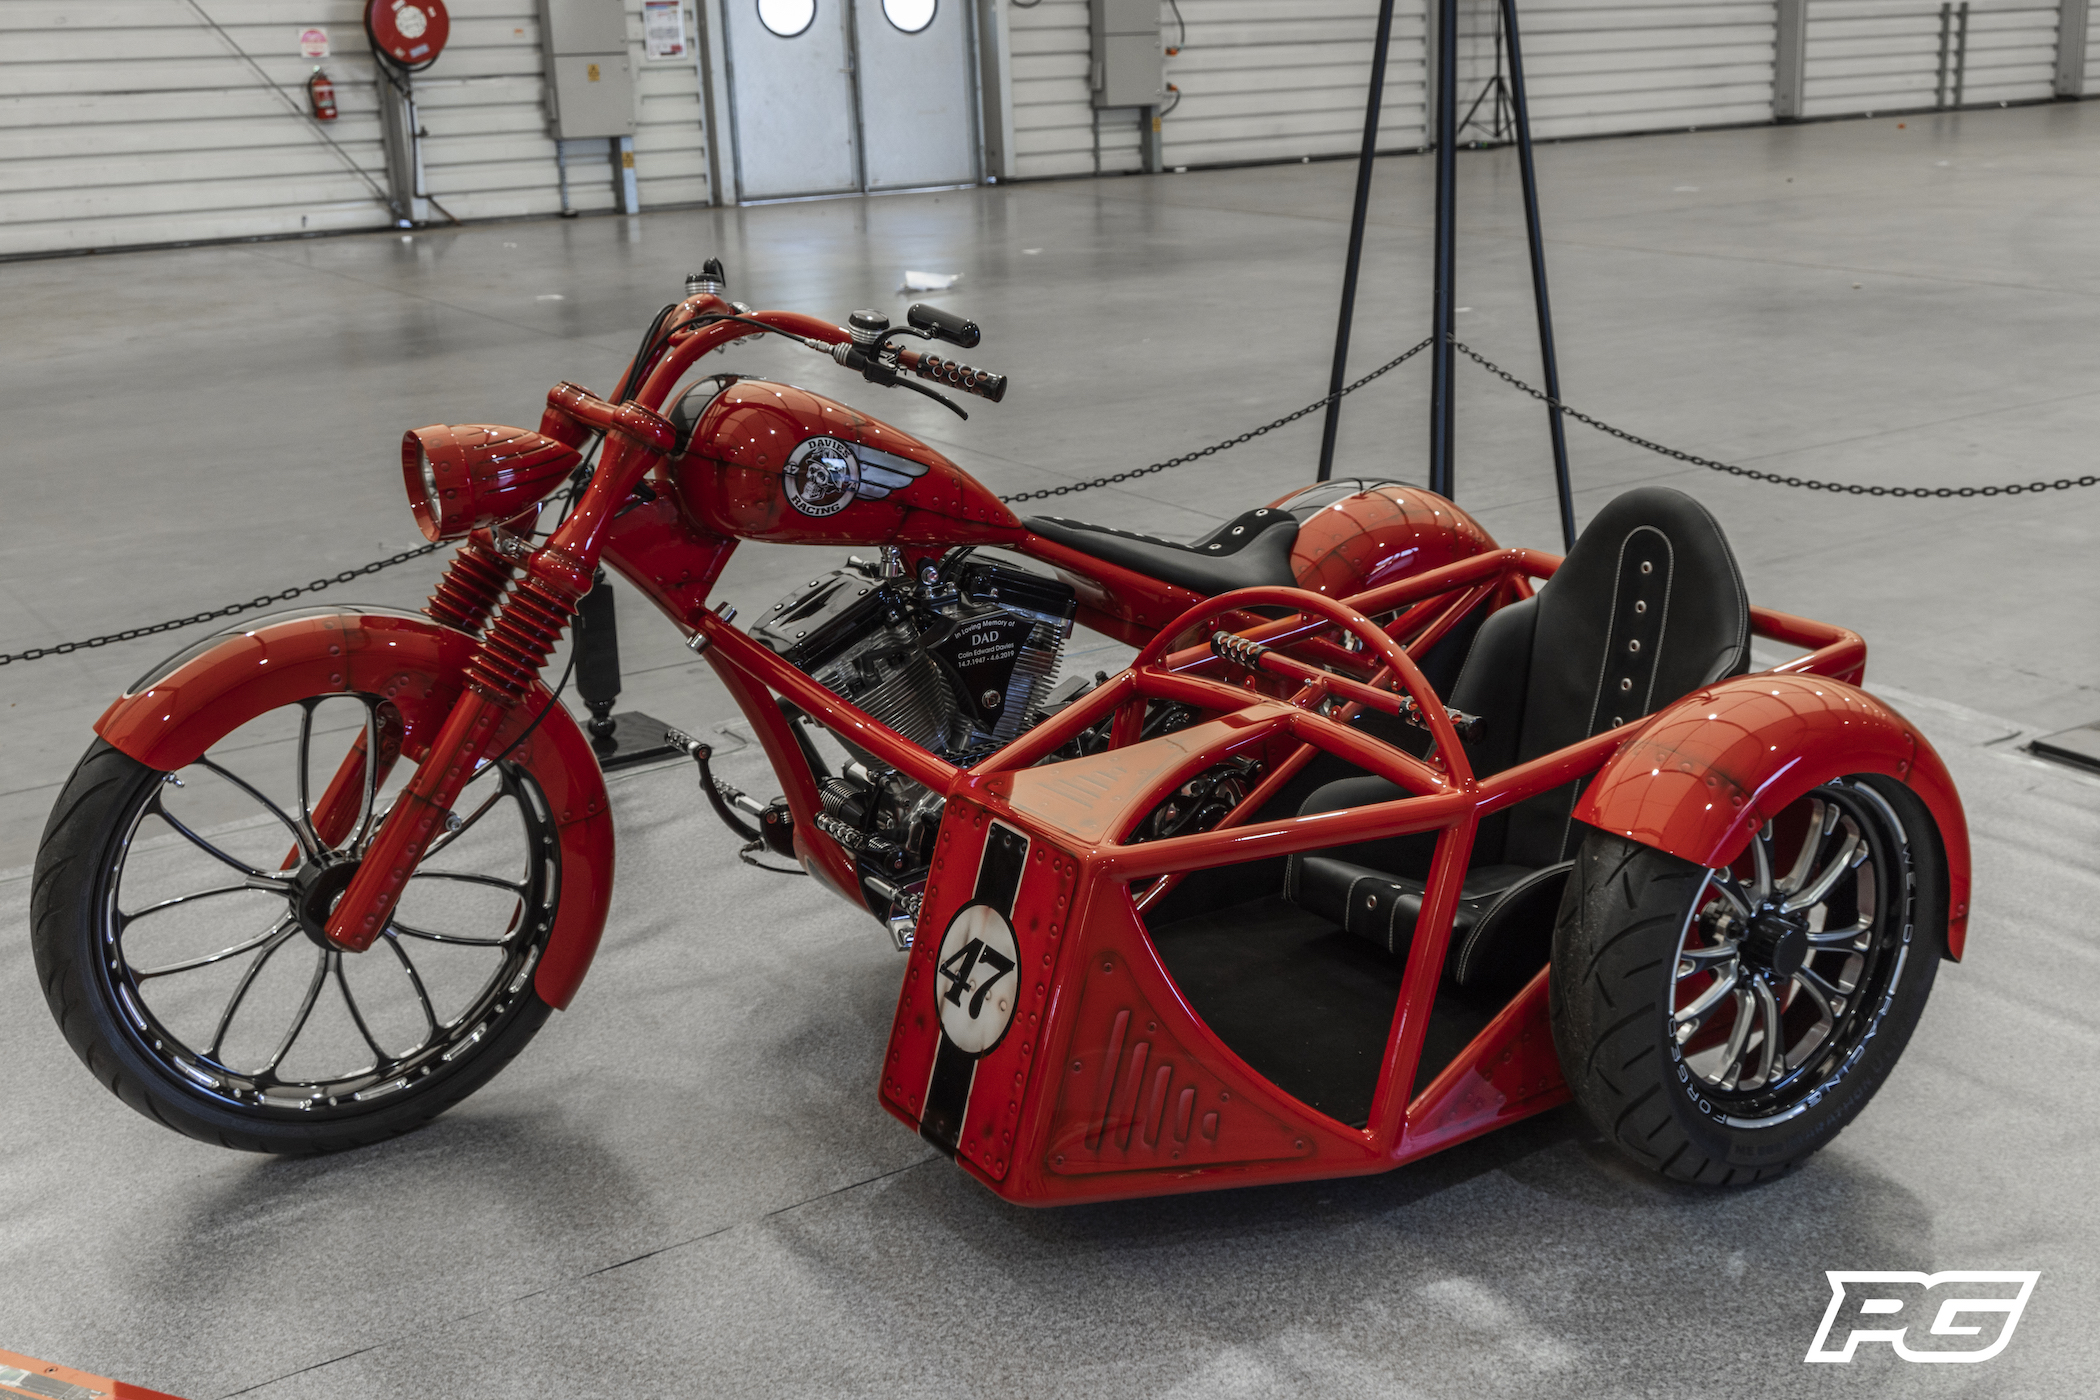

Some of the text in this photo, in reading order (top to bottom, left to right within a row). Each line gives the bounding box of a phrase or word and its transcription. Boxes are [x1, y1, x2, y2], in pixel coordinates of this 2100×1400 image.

[808, 439, 851, 459] DAVIES
[783, 464, 800, 475] 47
[791, 495, 840, 515] RACING
[954, 632, 962, 640] In
[961, 623, 982, 635] Loving
[971, 630, 999, 646] DAD
[957, 642, 1015, 660] Colin Edward Davies
[1902, 843, 1917, 943] WELD
[939, 937, 1016, 1020] 47
[1806, 995, 1893, 1109] RACING
[1668, 1017, 1728, 1125] FORGED
